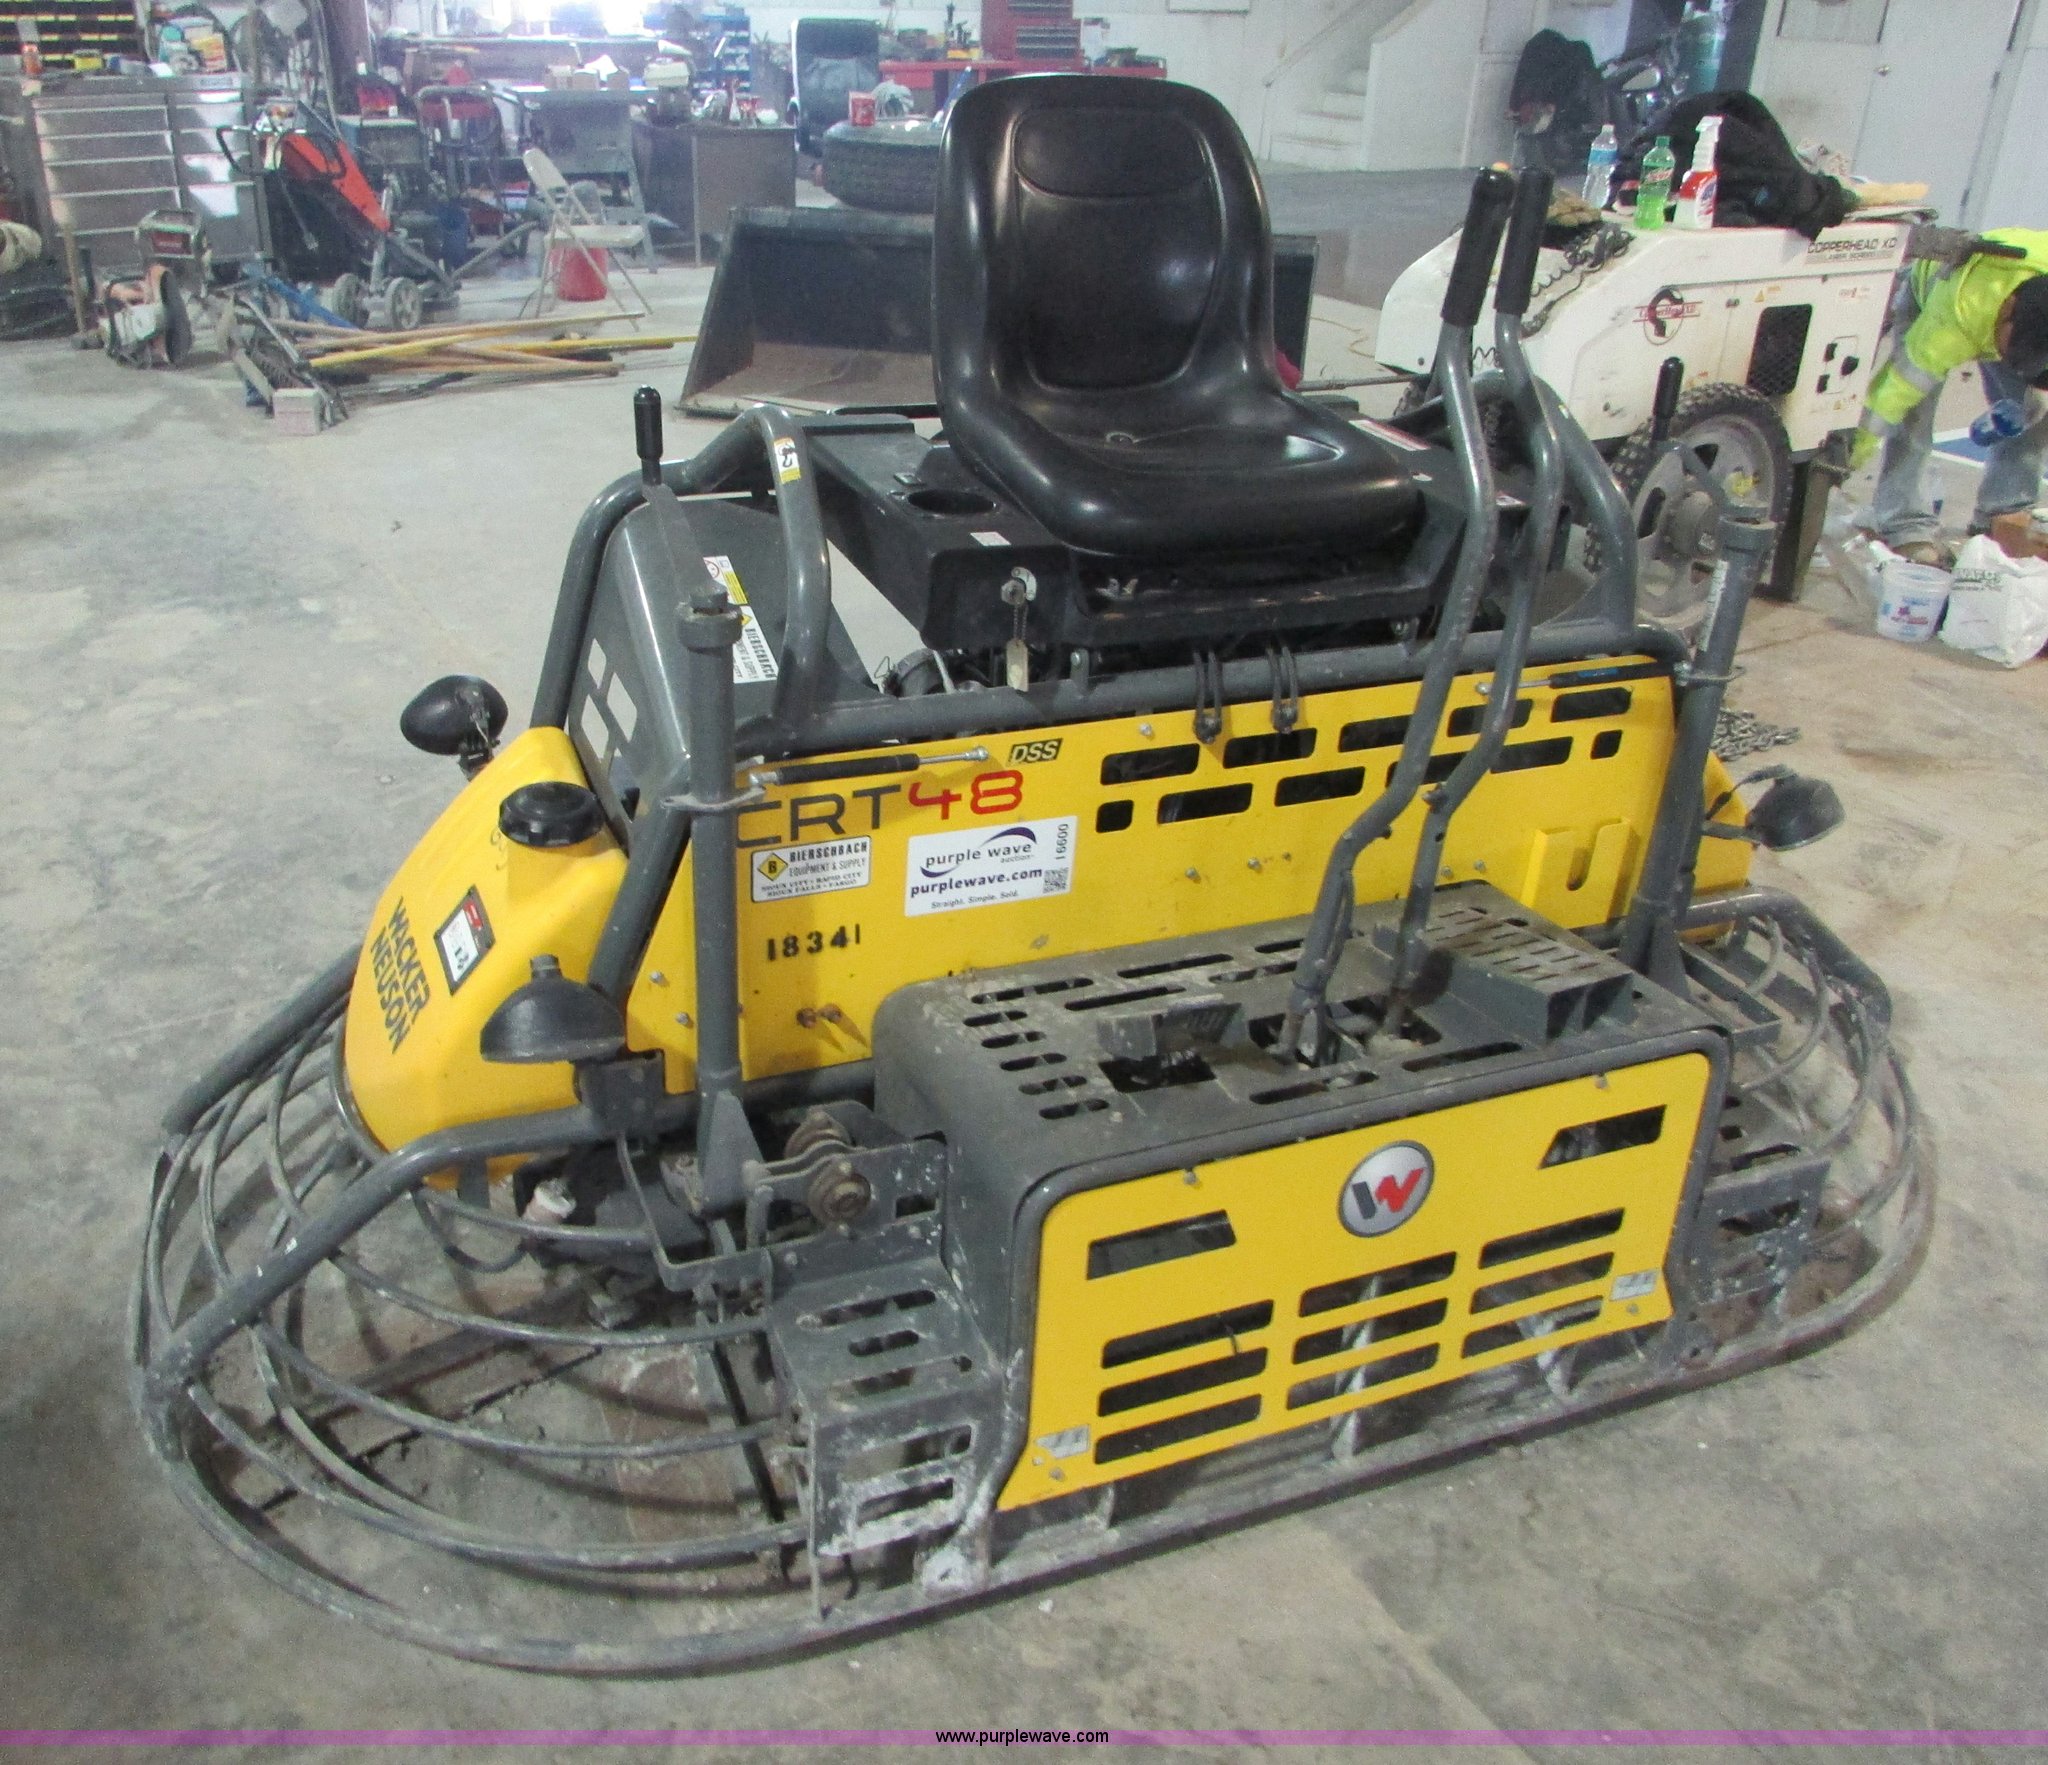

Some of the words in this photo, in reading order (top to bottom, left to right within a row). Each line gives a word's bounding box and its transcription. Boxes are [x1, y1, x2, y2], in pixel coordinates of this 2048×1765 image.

[1807, 238, 1879, 254] COPPERHEAD
[1010, 739, 1061, 765] DSS
[789, 842, 868, 863] BIERSCHBACH
[925, 848, 982, 868] purple
[988, 842, 1032, 858] wave
[1055, 823, 1069, 860] 16600
[789, 863, 830, 877] EQUIPMENT
[839, 858, 866, 870] SUPPLY
[910, 868, 1043, 898] purplewave.com
[767, 923, 861, 962] 18341
[388, 895, 431, 1025] WACKER
[370, 925, 411, 1055] NEUSON
